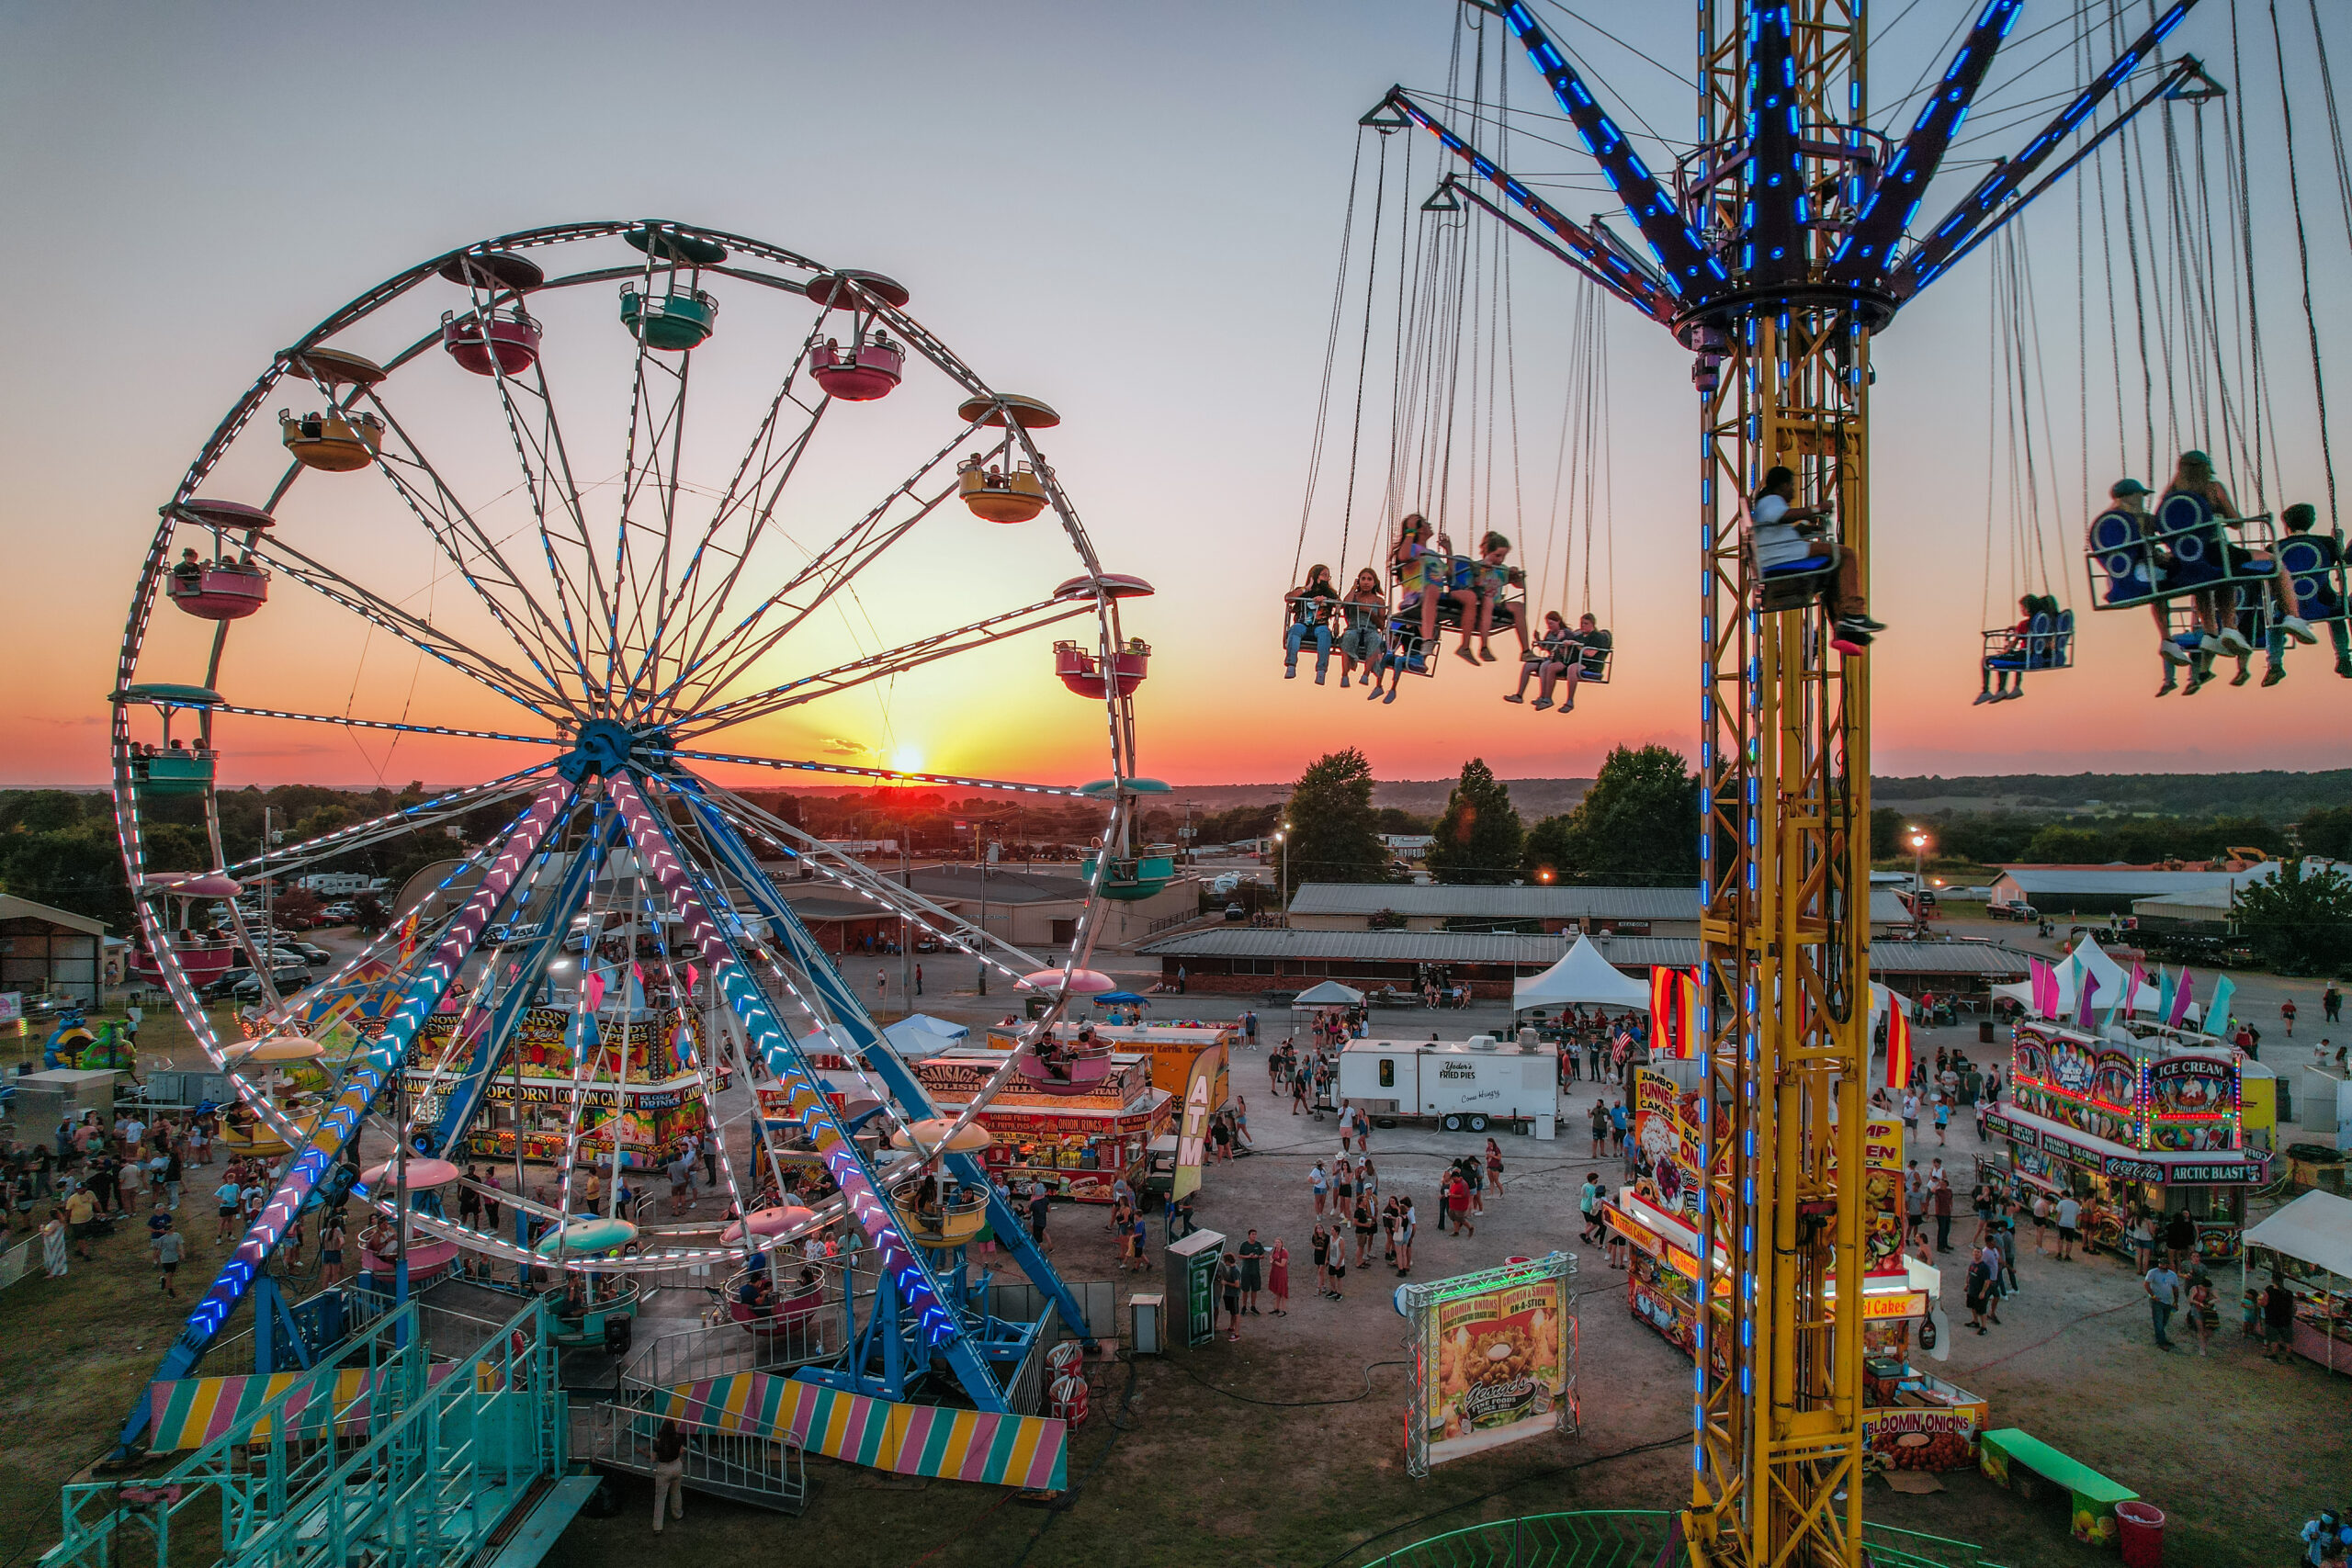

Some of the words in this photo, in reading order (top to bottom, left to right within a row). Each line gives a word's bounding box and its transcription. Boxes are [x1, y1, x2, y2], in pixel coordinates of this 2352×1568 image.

[920, 1066, 977, 1083] SAUSAGE
[1440, 1071, 1459, 1079] FRIED
[1460, 1071, 1476, 1079] PIES
[1442, 1061, 1473, 1073] Yoder's
[2159, 1064, 2178, 1077] ICE
[2181, 1061, 2223, 1077] CREAM
[922, 1083, 980, 1091] POLISH
[1642, 1071, 1674, 1091] JUMBO
[486, 1085, 549, 1102] OPCORN
[1478, 1089, 1500, 1100] Hungry
[1639, 1082, 1675, 1112] FUNNEL
[1640, 1100, 1674, 1122] CAKES
[1057, 1119, 1079, 1130] ONION
[1080, 1119, 1102, 1132] RINGS
[1179, 1075, 1209, 1167] ATM
[1986, 1114, 2009, 1130] COFFEE
[2011, 1122, 2035, 1137] ARCTIC
[2012, 1130, 2035, 1145] BLAST
[2044, 1135, 2069, 1150] SHAKES
[2049, 1144, 2070, 1159] FLOATS
[2072, 1145, 2082, 1156] ICE
[2082, 1147, 2100, 1164] CREAM
[2173, 1167, 2210, 1179] ARCTIC
[2211, 1167, 2245, 1179] BLAST
[1615, 1219, 1634, 1235] Funnel
[1634, 1229, 1648, 1247] Cakes
[1502, 1288, 1527, 1307] CHICKEN
[1527, 1288, 1532, 1298] &
[1532, 1285, 1555, 1298] SHRIMP
[1442, 1301, 1474, 1320] BLOOMIN'
[1474, 1298, 1498, 1311] ONIONS
[1510, 1298, 1546, 1314] ON-A-STICK
[1874, 1300, 1905, 1314] Cakes
[1430, 1313, 1440, 1407] LEMONADE
[1465, 1372, 1526, 1403] George's
[1472, 1401, 1490, 1413] FINE
[1491, 1396, 1517, 1405] FOODS
[1477, 1404, 1497, 1415] SINCE
[1867, 1414, 1923, 1436] BLOOMIN'
[1925, 1414, 1969, 1433] ONIONS
